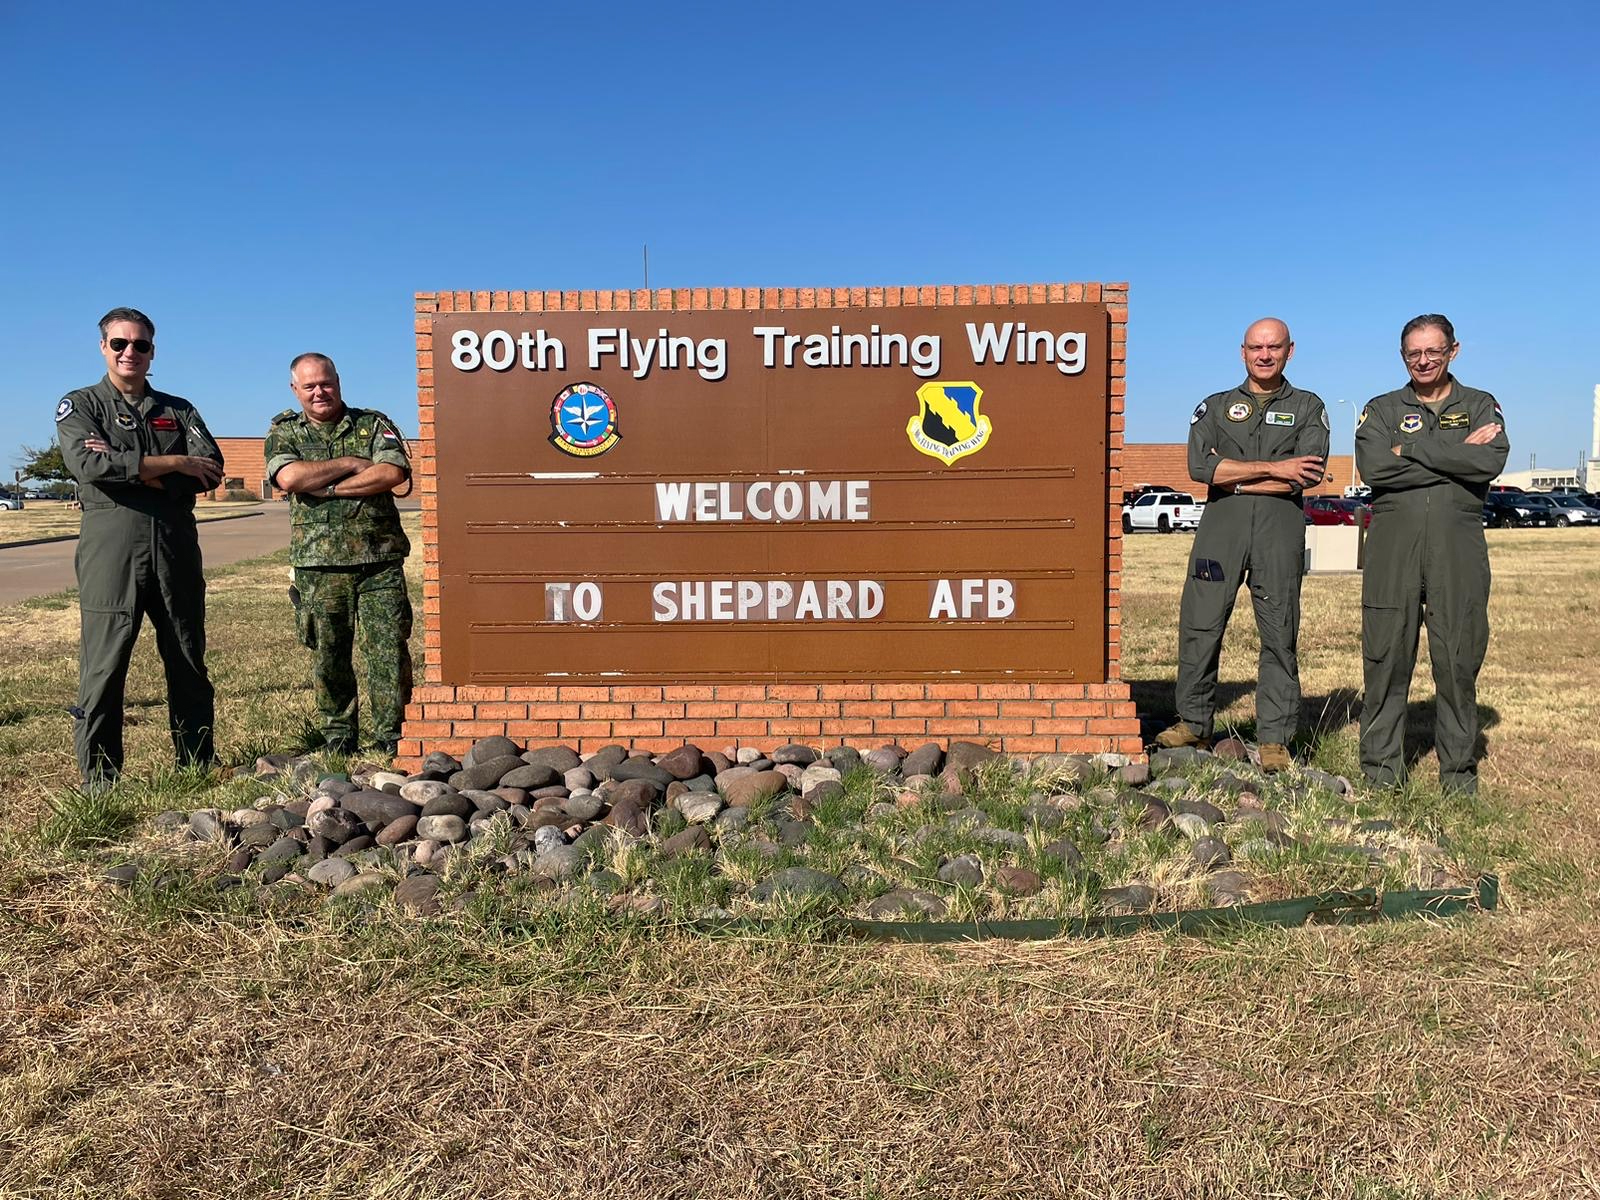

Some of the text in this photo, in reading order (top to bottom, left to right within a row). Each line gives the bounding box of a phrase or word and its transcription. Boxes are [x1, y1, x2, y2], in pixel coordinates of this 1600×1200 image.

[450, 322, 1087, 380] 80th Flying Training Wing
[655, 480, 870, 522] WELCOME
[545, 578, 1015, 622] TO SHEPPARD AFB
